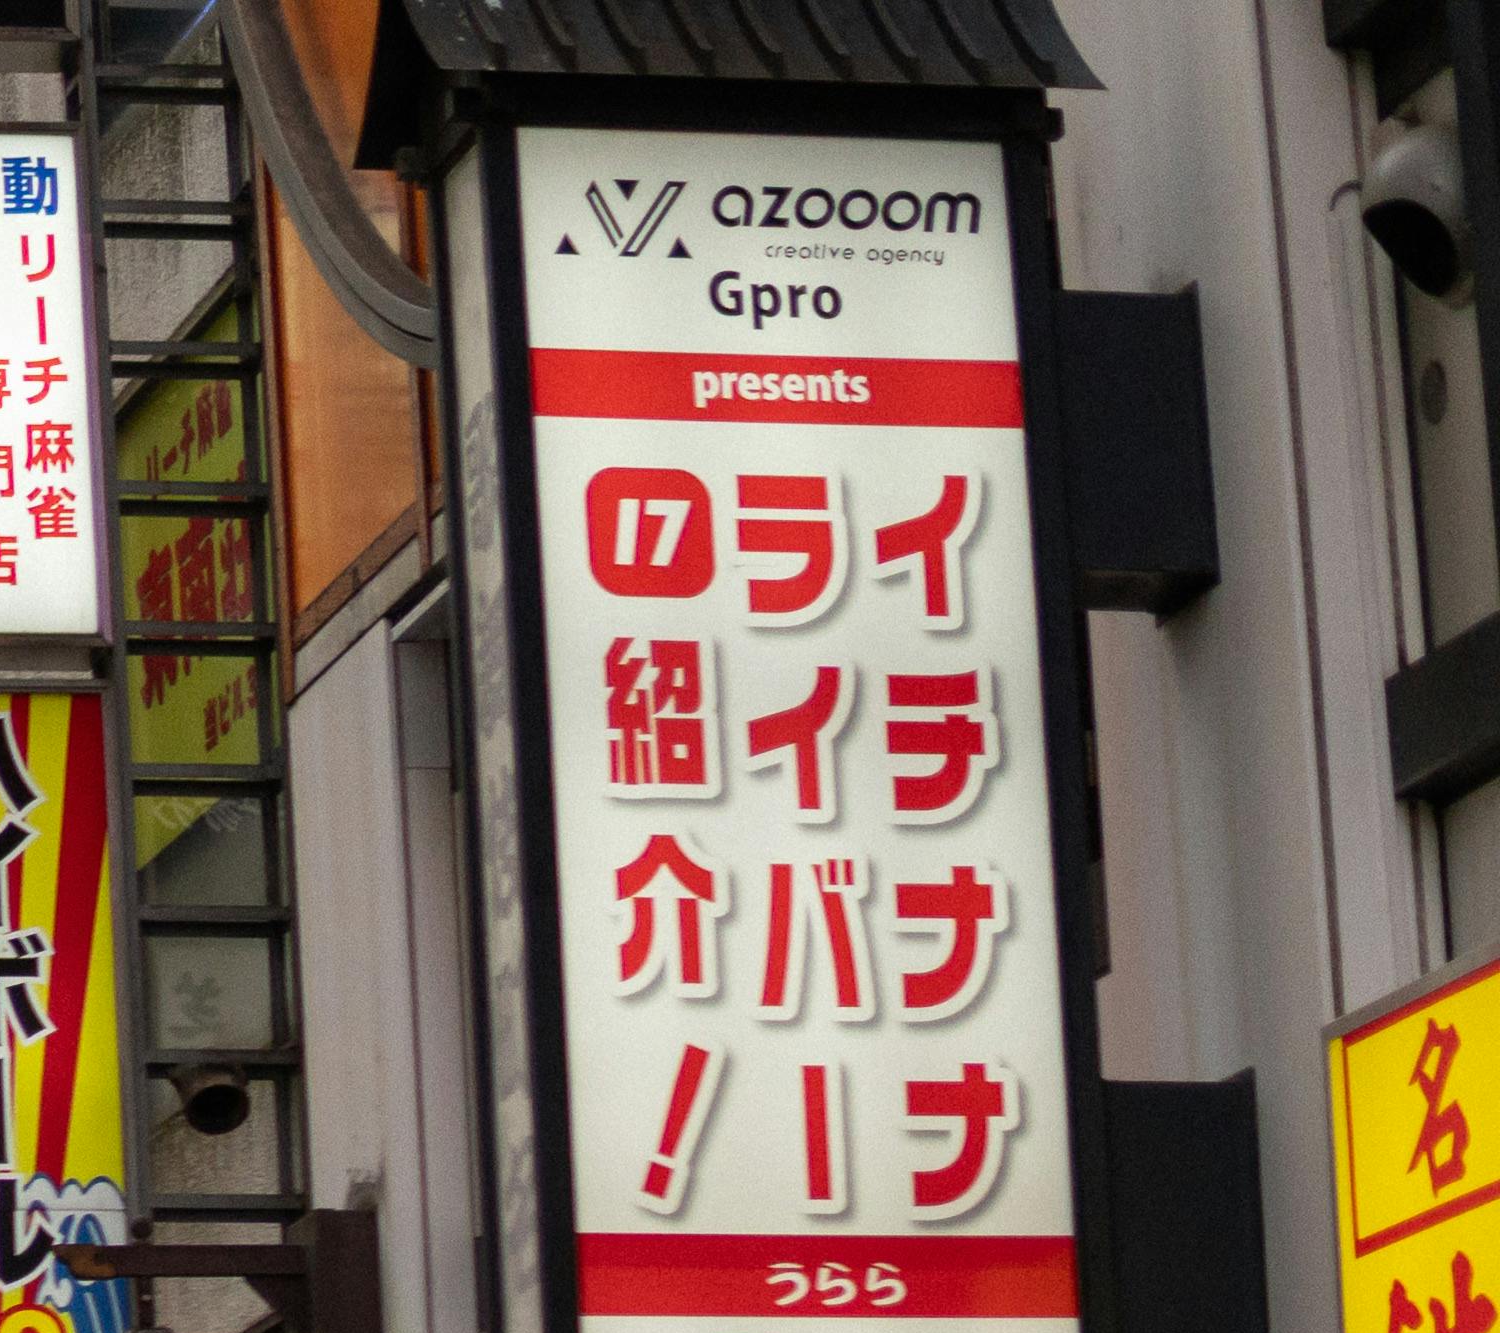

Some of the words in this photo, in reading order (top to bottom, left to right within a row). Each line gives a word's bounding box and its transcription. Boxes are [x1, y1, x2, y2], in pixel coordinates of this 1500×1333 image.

[712, 179, 981, 235] azooom
[764, 242, 855, 264] creative
[866, 245, 946, 267] agency
[708, 271, 844, 330] Gpro
[21, 234, 79, 539] リーチ麻雀
[692, 365, 872, 409] presents
[733, 475, 875, 1200] ライバー
[876, 475, 1009, 1207] イチナナ
[766, 1263, 907, 1307] うらら
